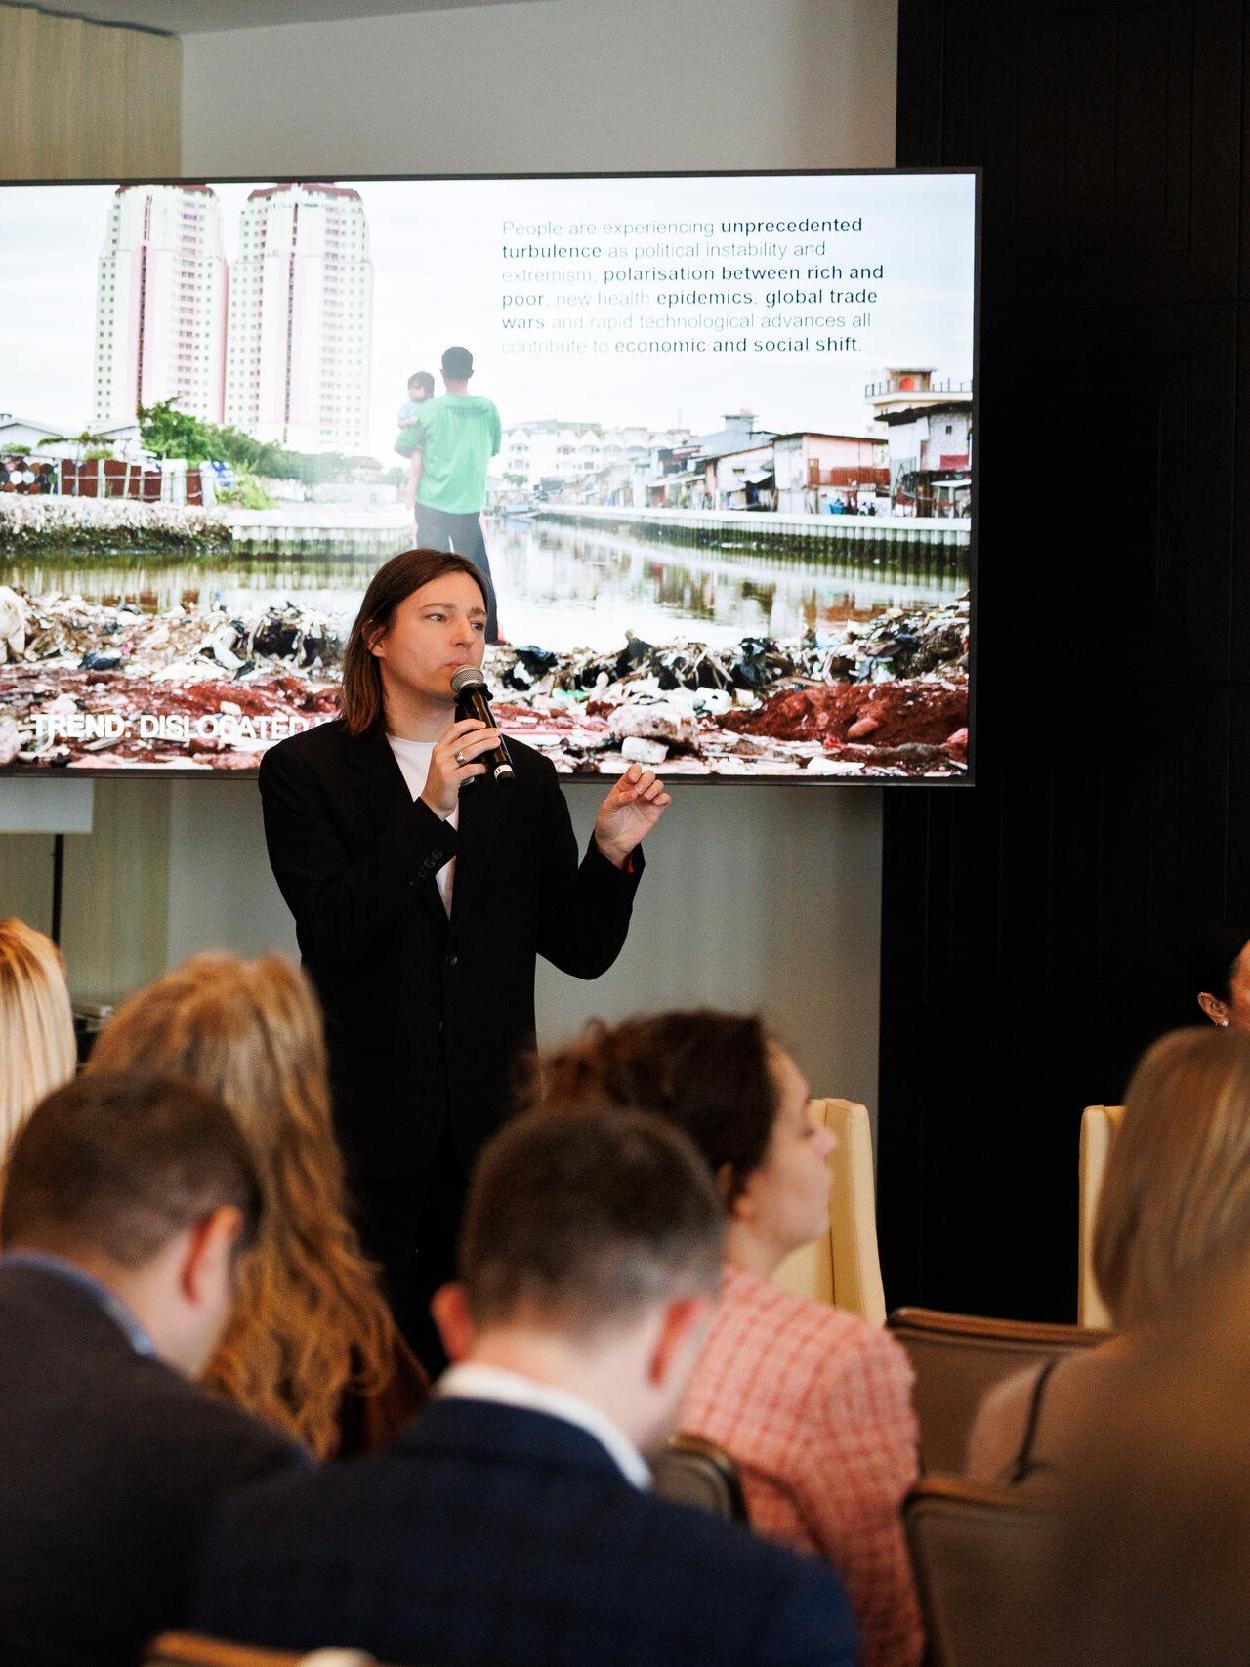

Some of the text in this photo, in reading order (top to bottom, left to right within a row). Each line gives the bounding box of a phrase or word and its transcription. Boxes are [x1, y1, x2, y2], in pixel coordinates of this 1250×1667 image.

[502, 217, 862, 238] People are experiencing unprecedented
[502, 240, 826, 261] turbulence as political instability and
[502, 264, 885, 285] extremism, polarisation between rich and
[556, 294, 592, 306] new
[598, 291, 650, 306] health
[765, 288, 823, 308] global
[829, 288, 878, 304] trade
[502, 312, 871, 332] wars and rapid technological advances all
[501, 336, 862, 354] contribute to economic and social shift.
[30, 714, 131, 738] TREND:
[140, 714, 310, 740] DISLOCATED
